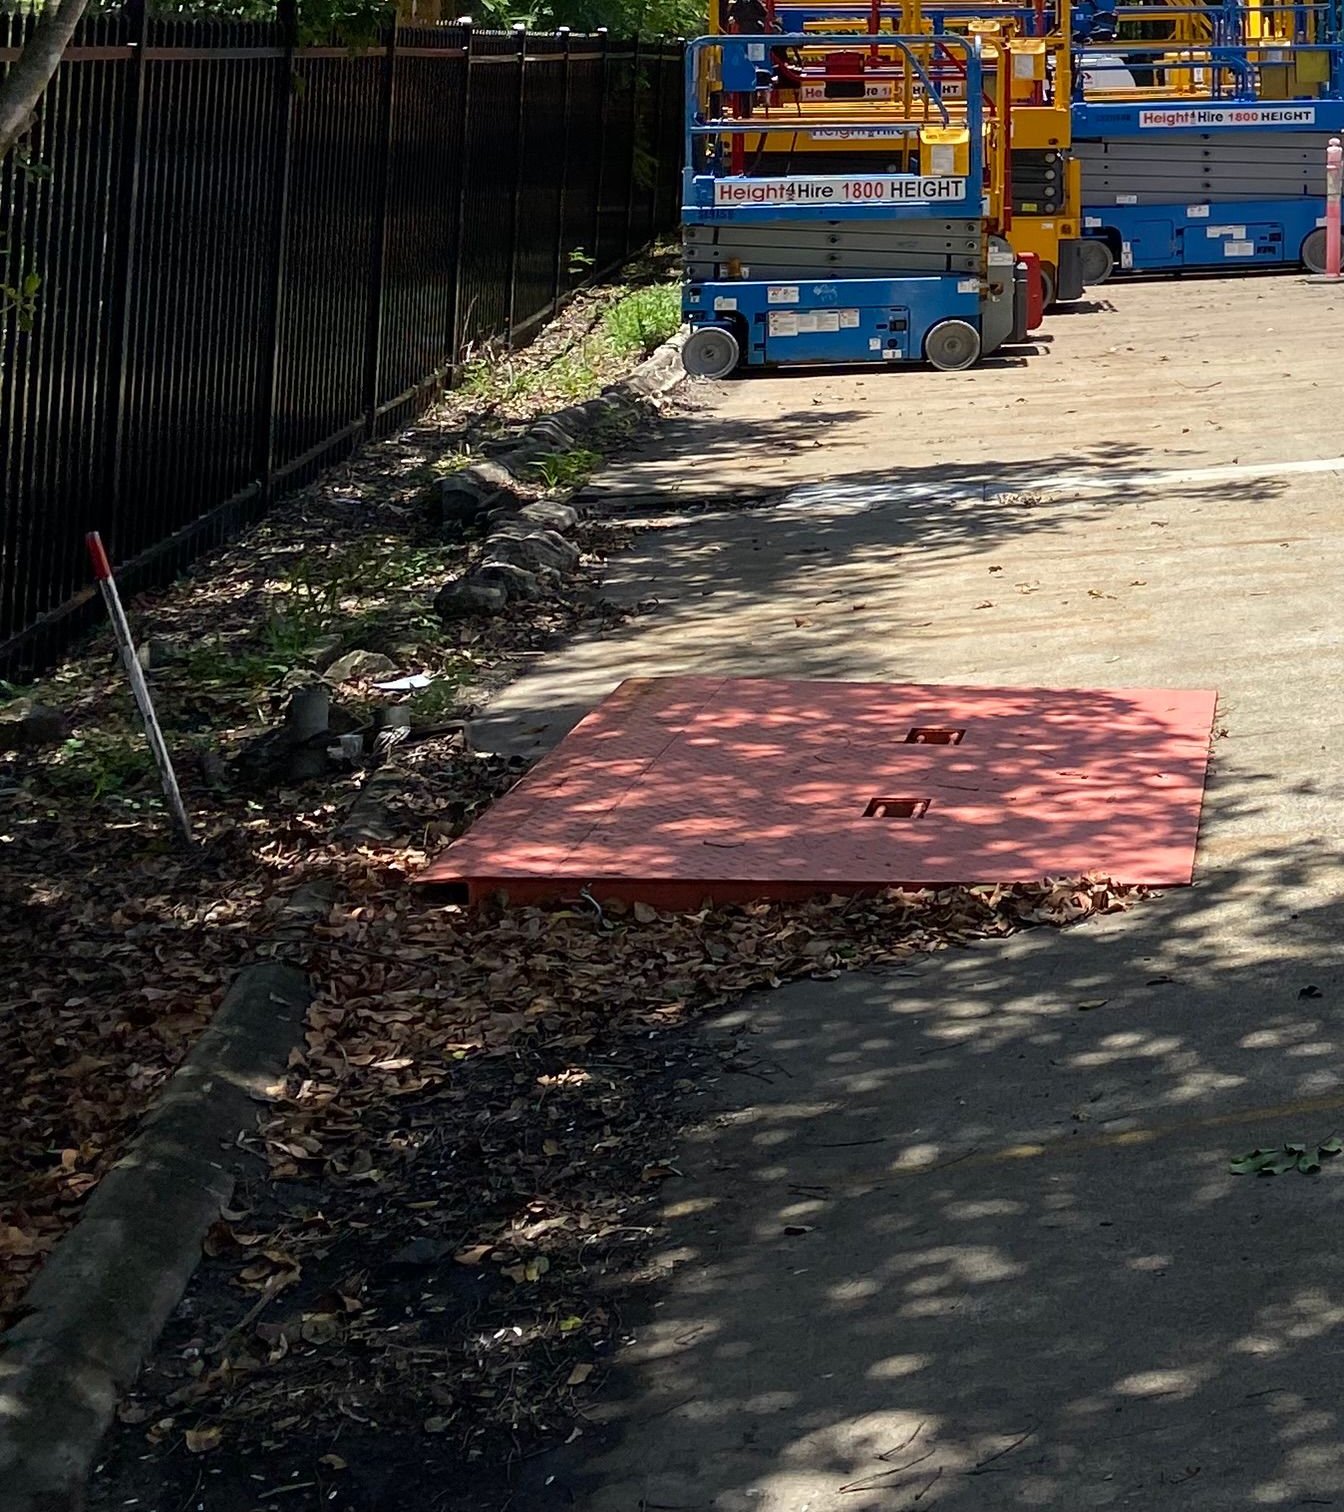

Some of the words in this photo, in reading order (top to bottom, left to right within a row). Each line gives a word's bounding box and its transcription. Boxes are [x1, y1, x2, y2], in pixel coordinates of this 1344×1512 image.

[1143, 109, 1223, 126] Height4Hire
[1227, 111, 1259, 122] 1800
[1260, 111, 1312, 121] HEIGHT
[719, 180, 834, 202] Height4Hire
[842, 181, 884, 199] 1800
[891, 179, 963, 198] HEIGHT
